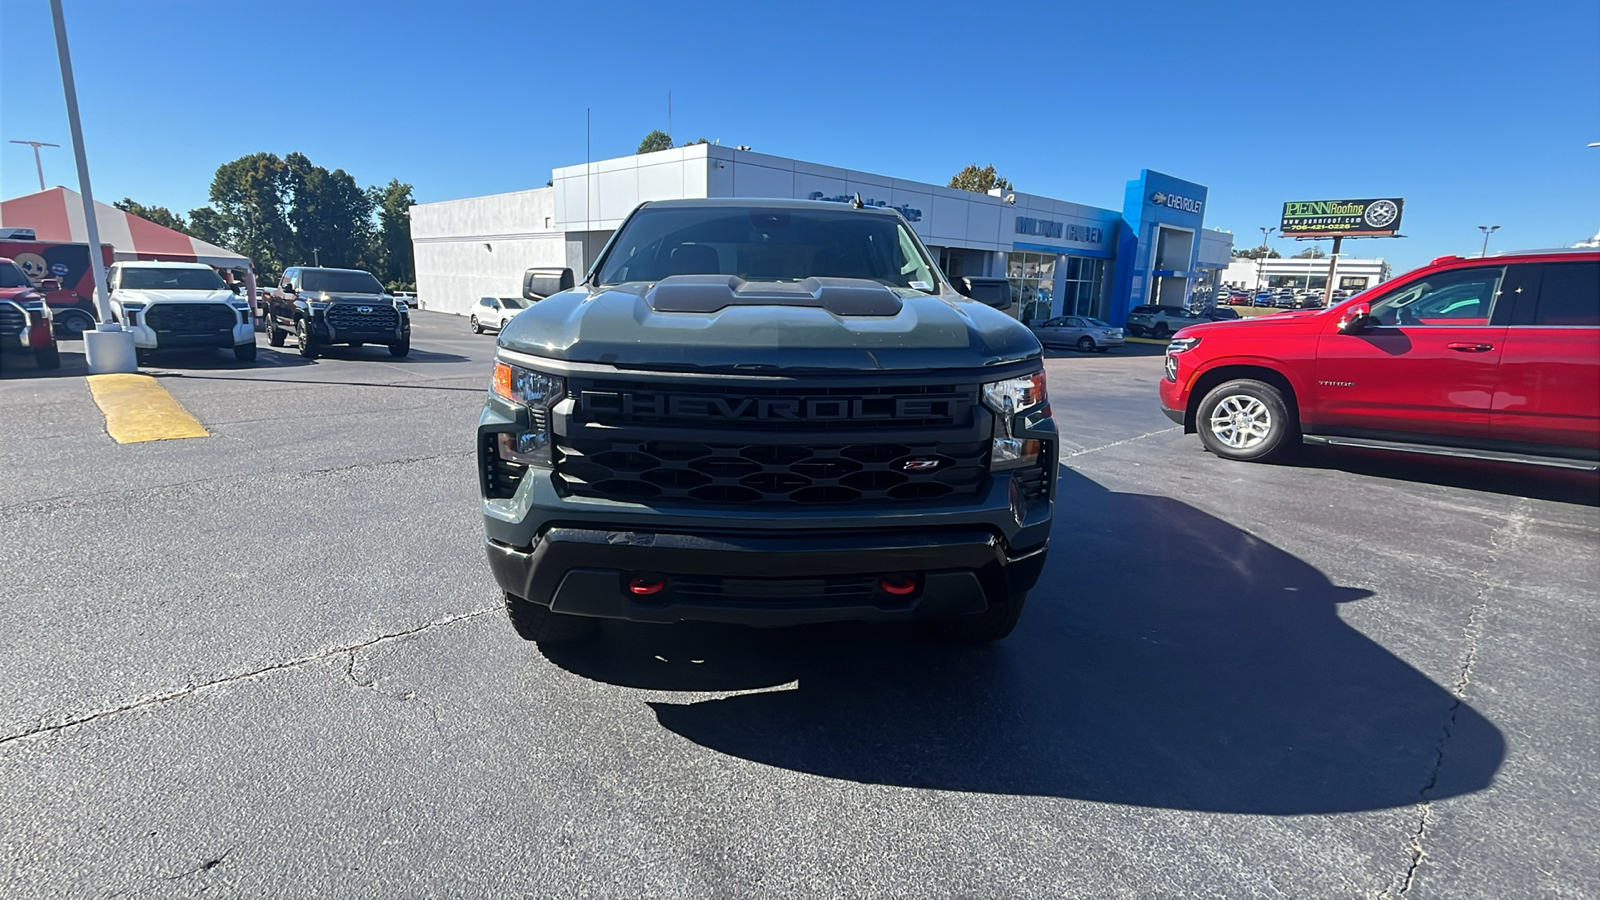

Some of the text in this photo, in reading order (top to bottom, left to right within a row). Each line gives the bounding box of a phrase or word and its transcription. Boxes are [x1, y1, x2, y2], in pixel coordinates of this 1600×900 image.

[1167, 194, 1203, 213] CHEVROLET
[1284, 201, 1341, 216] PENN
[1330, 202, 1364, 216] Roofing
[1283, 217, 1362, 226] www.pennroof.com
[582, 389, 969, 421] CHEVROLET
[903, 460, 940, 470] Z71
